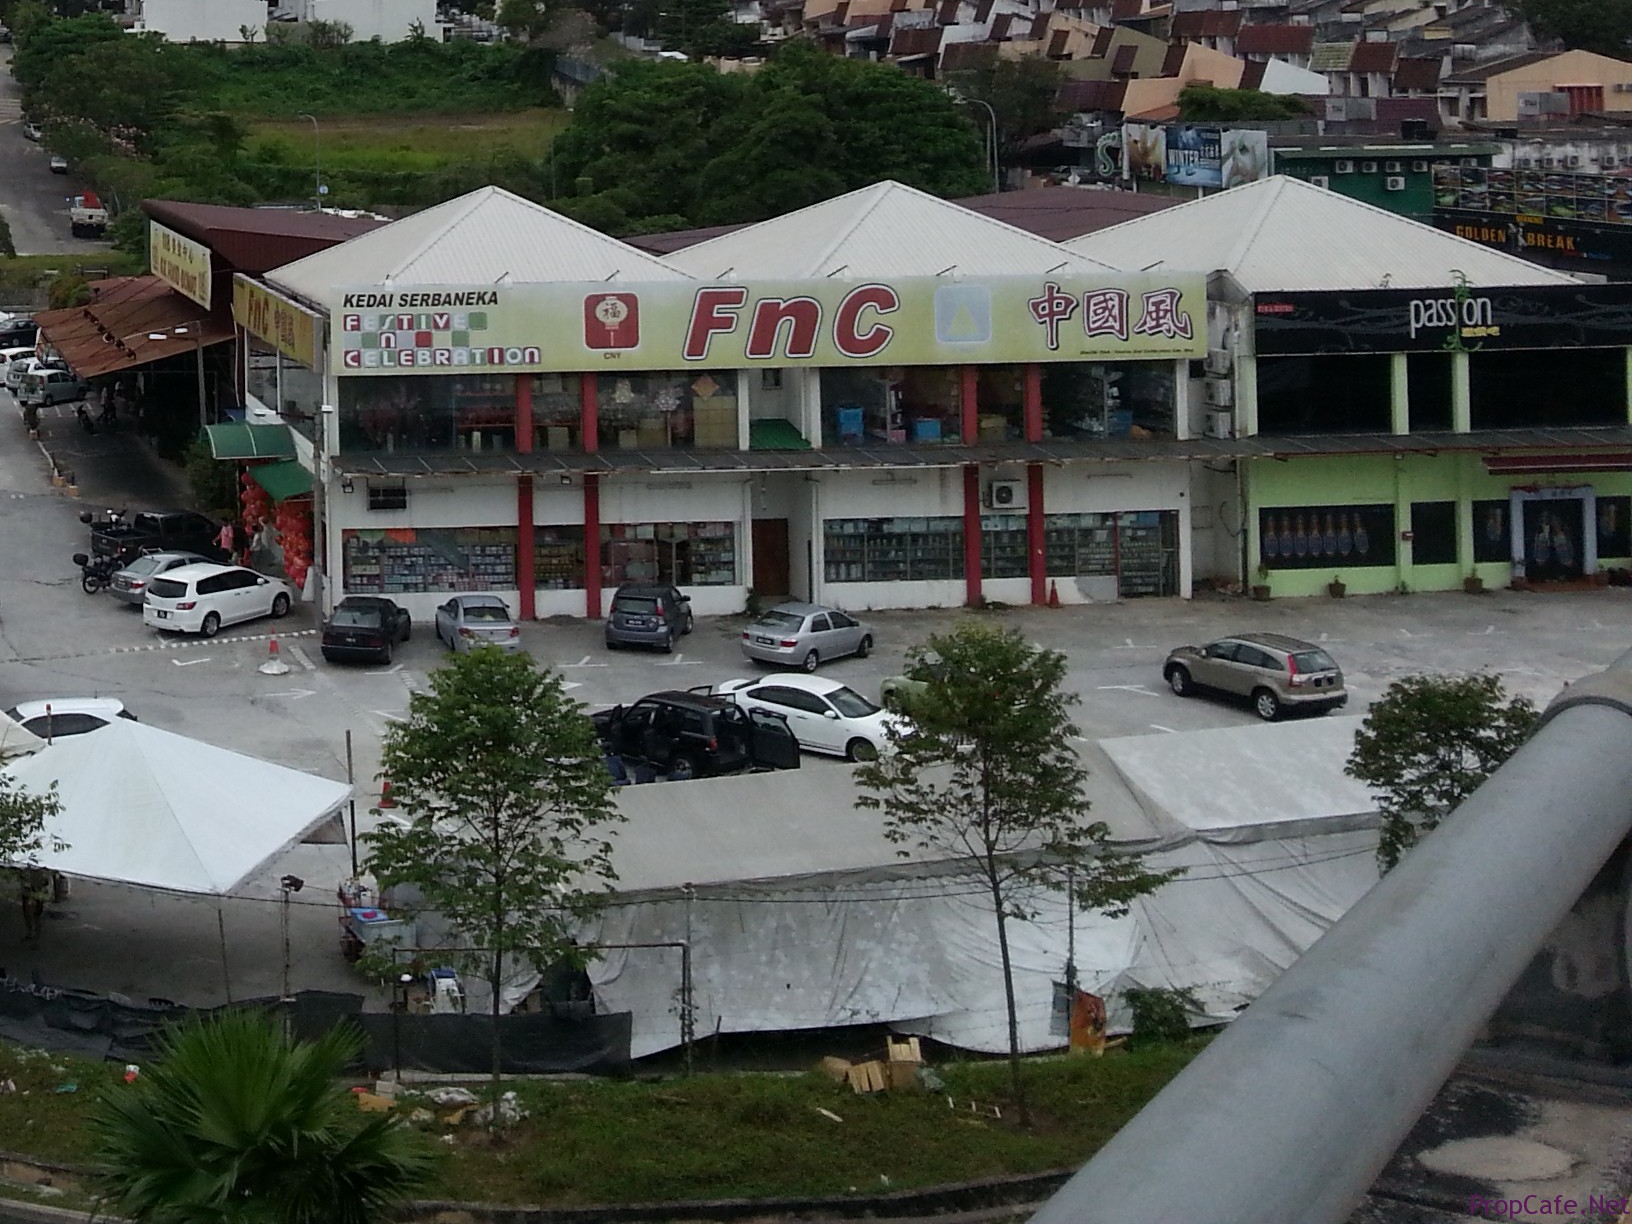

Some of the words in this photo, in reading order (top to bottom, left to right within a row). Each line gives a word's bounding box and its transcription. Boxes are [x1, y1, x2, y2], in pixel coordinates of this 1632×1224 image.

[1168, 148, 1199, 167] WINTER
[1455, 224, 1507, 244] GOLDEN
[1526, 232, 1575, 250] BREAK
[343, 293, 394, 308] KEDAI
[398, 291, 499, 308] SERBANEKA
[345, 313, 467, 331] FESTIVE
[683, 283, 900, 361] FnC
[1028, 281, 1194, 351] 中國風
[603, 352, 622, 360] CNY
